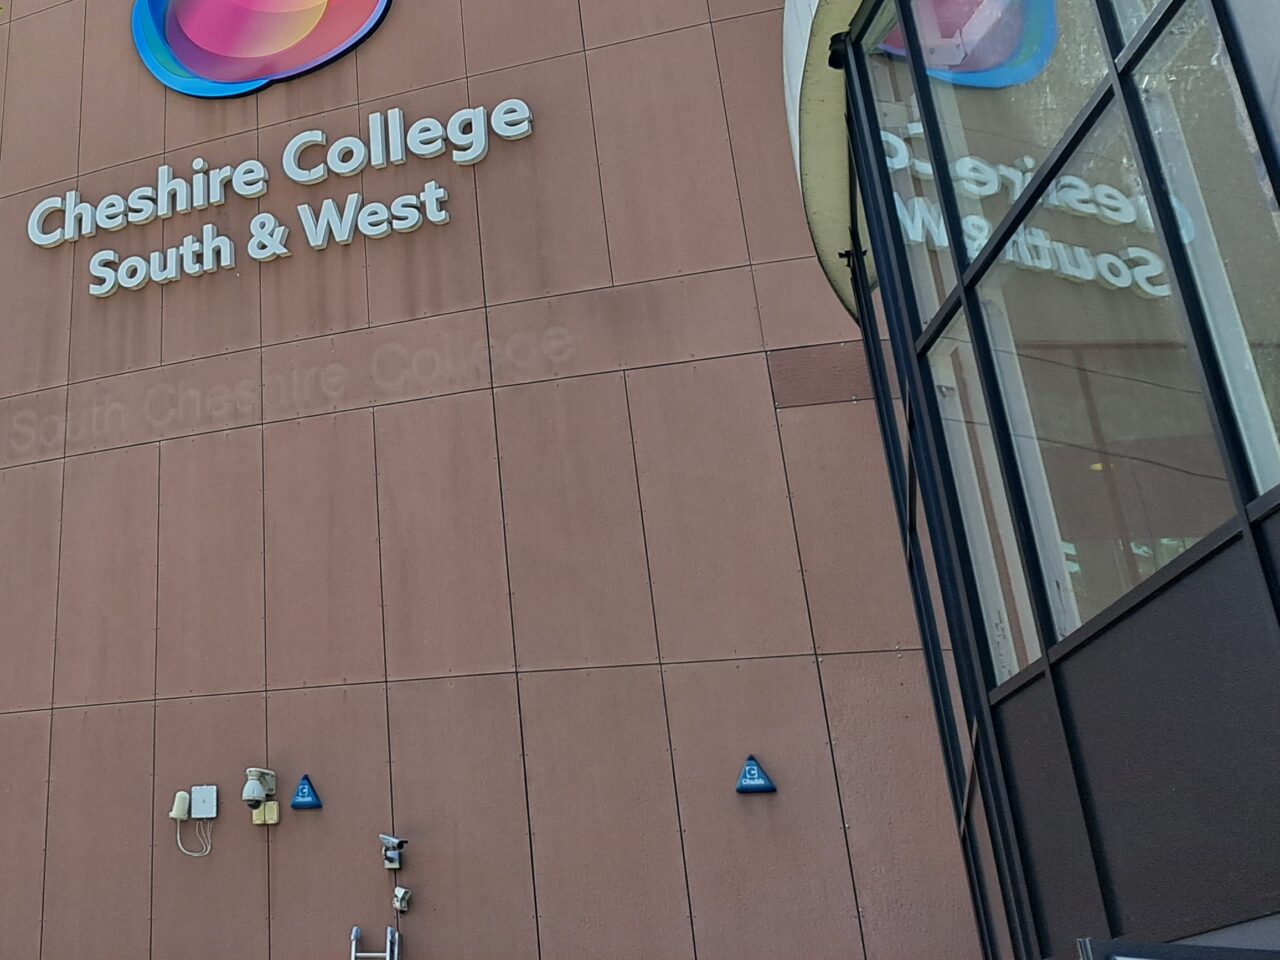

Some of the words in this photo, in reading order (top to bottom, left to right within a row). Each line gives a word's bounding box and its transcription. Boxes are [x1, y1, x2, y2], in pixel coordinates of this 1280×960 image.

[27, 157, 268, 248] Cheshire
[281, 97, 534, 185] College
[88, 222, 235, 298] South
[246, 211, 291, 262] &
[297, 179, 449, 250] West
